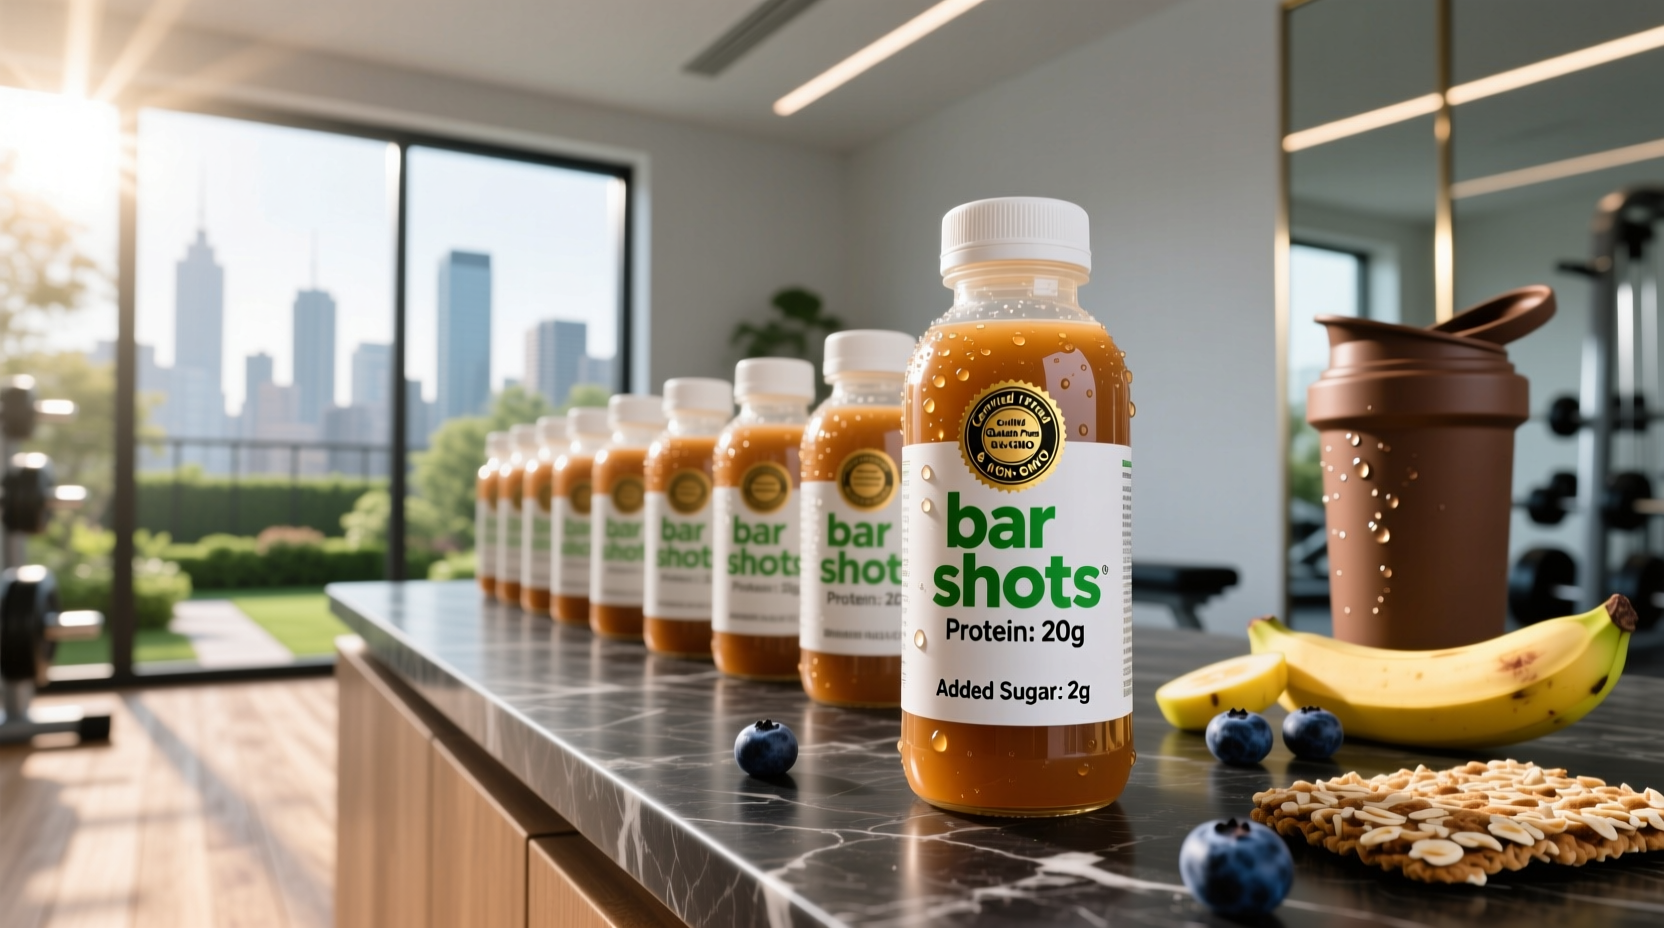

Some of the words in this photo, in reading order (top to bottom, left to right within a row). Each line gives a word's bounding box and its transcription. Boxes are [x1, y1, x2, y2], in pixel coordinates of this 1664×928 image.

[661, 516, 705, 542] bar
[733, 515, 787, 545] bar
[827, 512, 893, 548] bar
[947, 491, 1056, 550] bar
[657, 546, 713, 569] shot
[820, 551, 902, 586] shot
[946, 617, 1035, 643] Protein:
[1041, 619, 1085, 648] 20g
[936, 677, 994, 701] Added
[999, 680, 1063, 705] Sugar:
[1067, 680, 1091, 705] 2g
